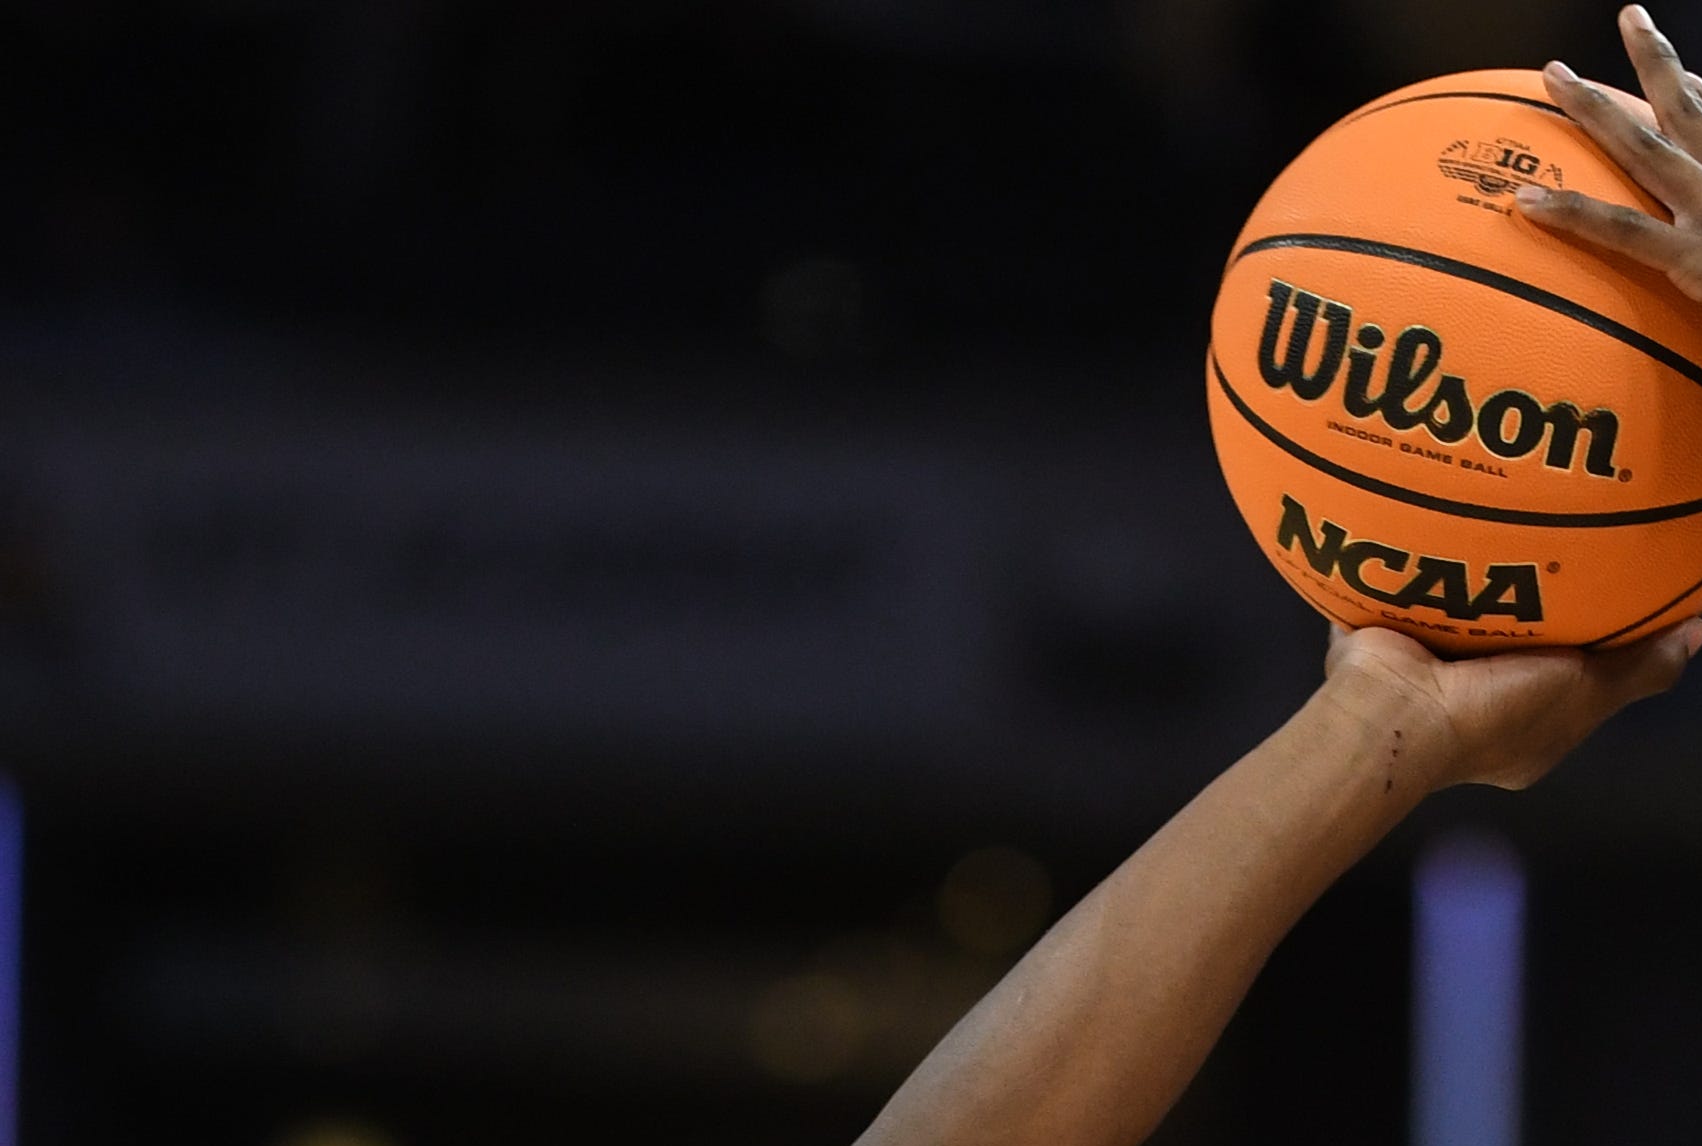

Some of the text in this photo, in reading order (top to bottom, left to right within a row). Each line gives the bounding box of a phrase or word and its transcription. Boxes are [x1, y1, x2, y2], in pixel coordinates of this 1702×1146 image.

[1258, 278, 1618, 480] Wilson
[1327, 420, 1509, 479] INDOOR GAME BALL
[1277, 494, 1545, 623] NCAA
[1380, 610, 1545, 638] GAME BALL
